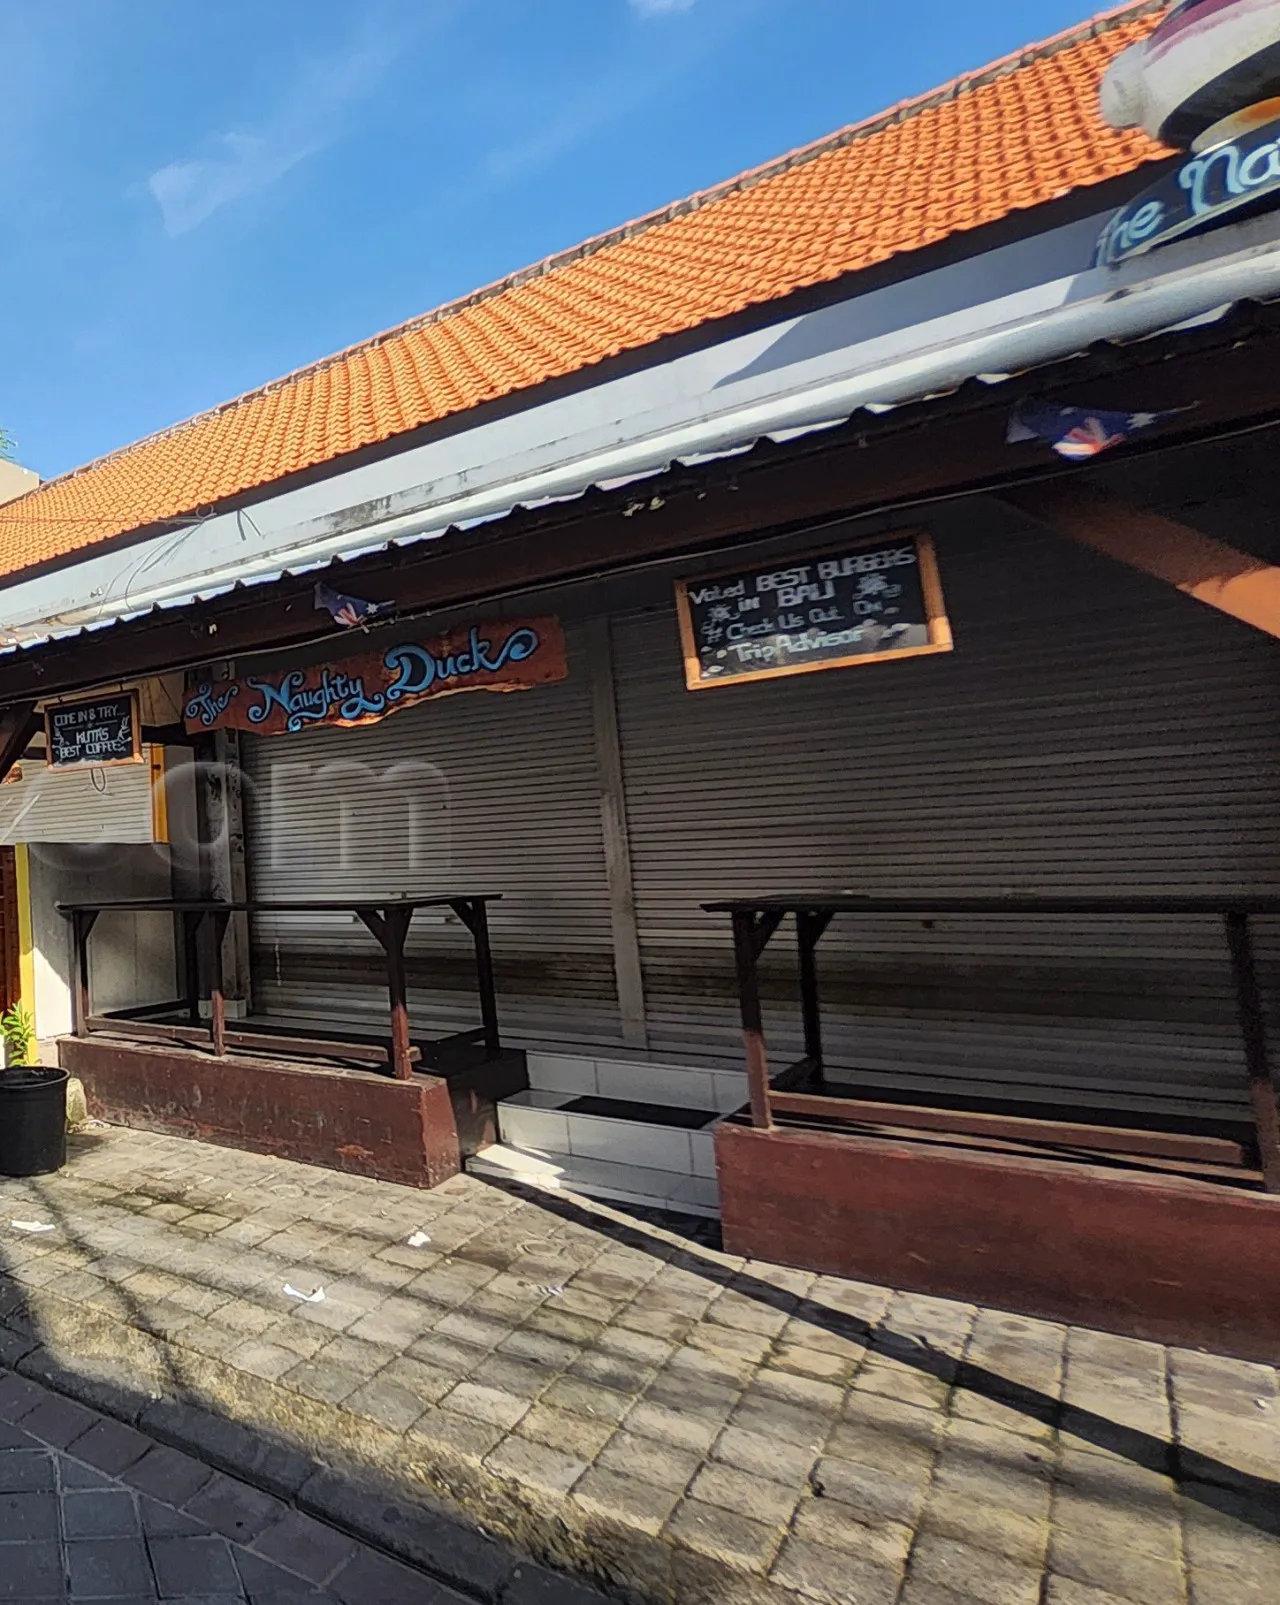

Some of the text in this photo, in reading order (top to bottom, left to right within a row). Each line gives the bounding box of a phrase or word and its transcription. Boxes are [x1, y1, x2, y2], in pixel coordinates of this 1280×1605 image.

[688, 546, 917, 604] Voted BEST BURGERS
[738, 580, 836, 612] in BALI
[185, 626, 538, 732] The Naughty Duck
[78, 709, 88, 723] IN
[60, 745, 81, 759] BEST
